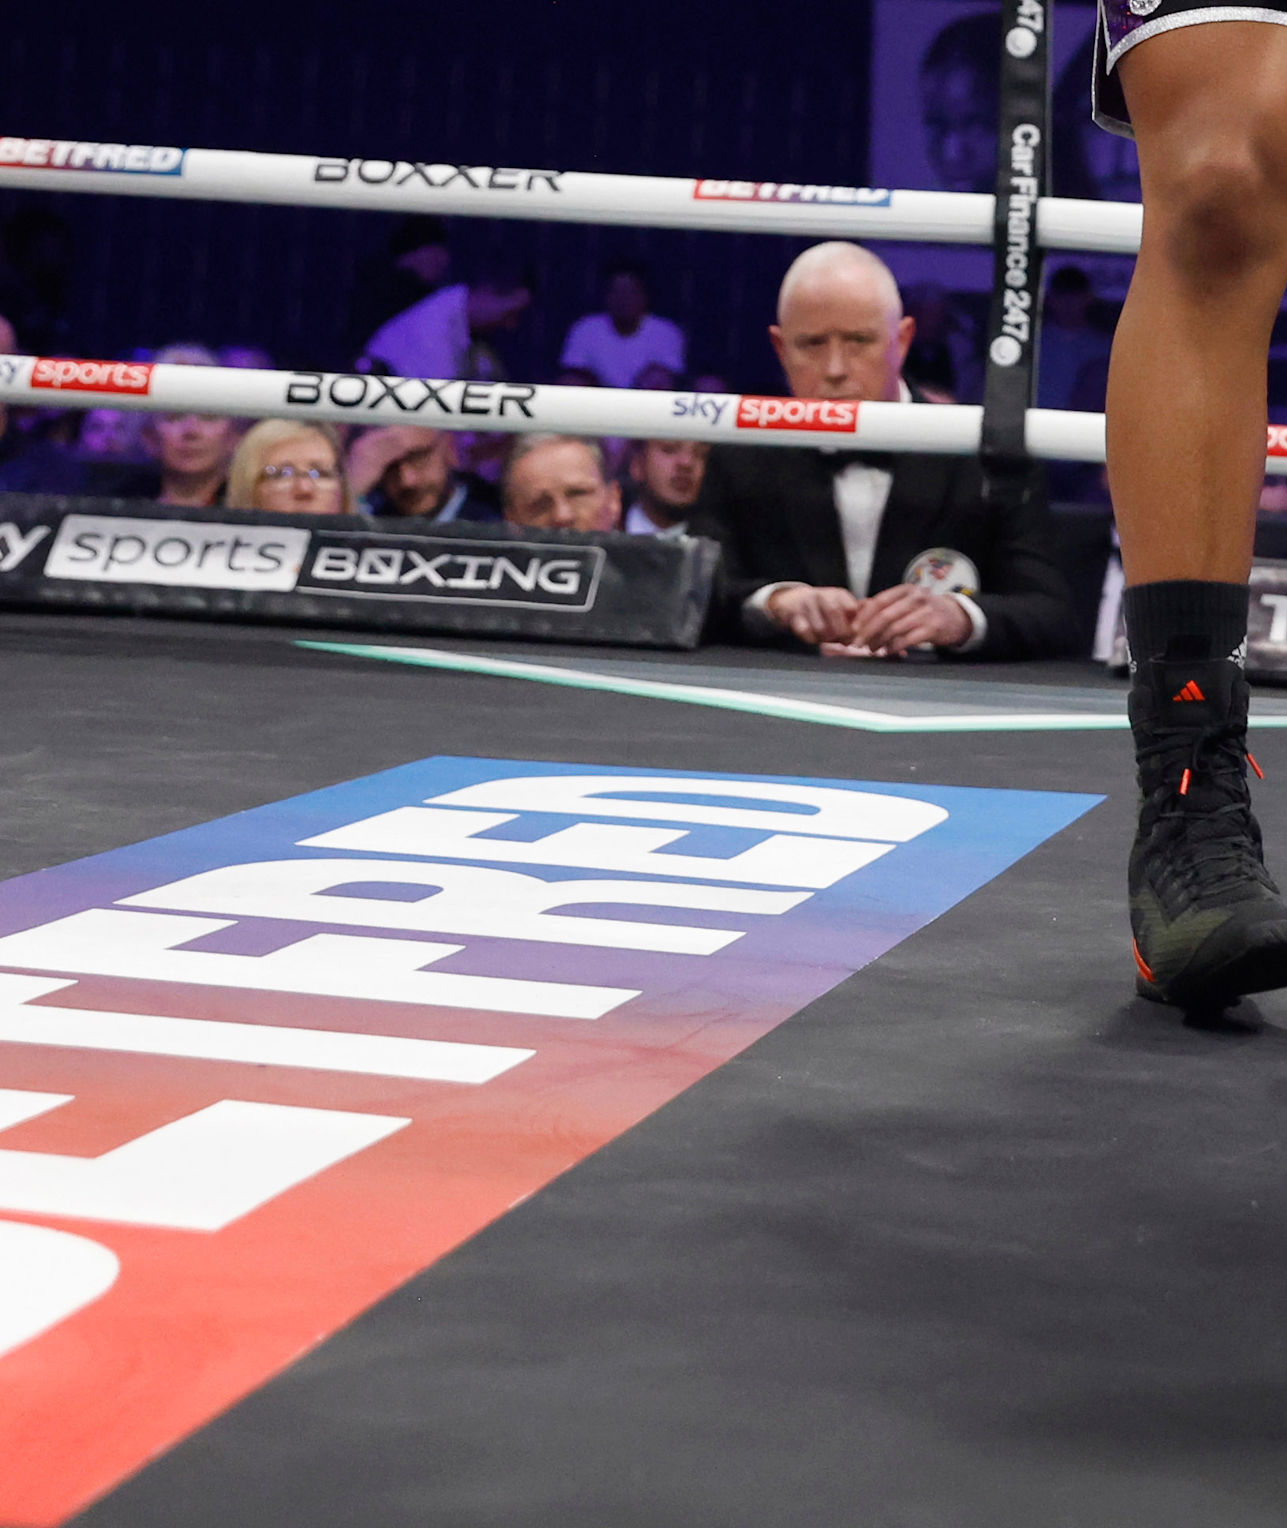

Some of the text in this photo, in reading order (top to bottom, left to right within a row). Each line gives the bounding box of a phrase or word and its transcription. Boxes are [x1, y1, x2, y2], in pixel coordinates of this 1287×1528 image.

[1011, 123, 1041, 172] Car
[314, 157, 562, 192] BOXXER
[1003, 289, 1031, 343] 247
[34, 359, 149, 389] sports
[286, 371, 536, 419] BOXXER
[673, 392, 855, 430] sky sports
[66, 528, 286, 573] sports
